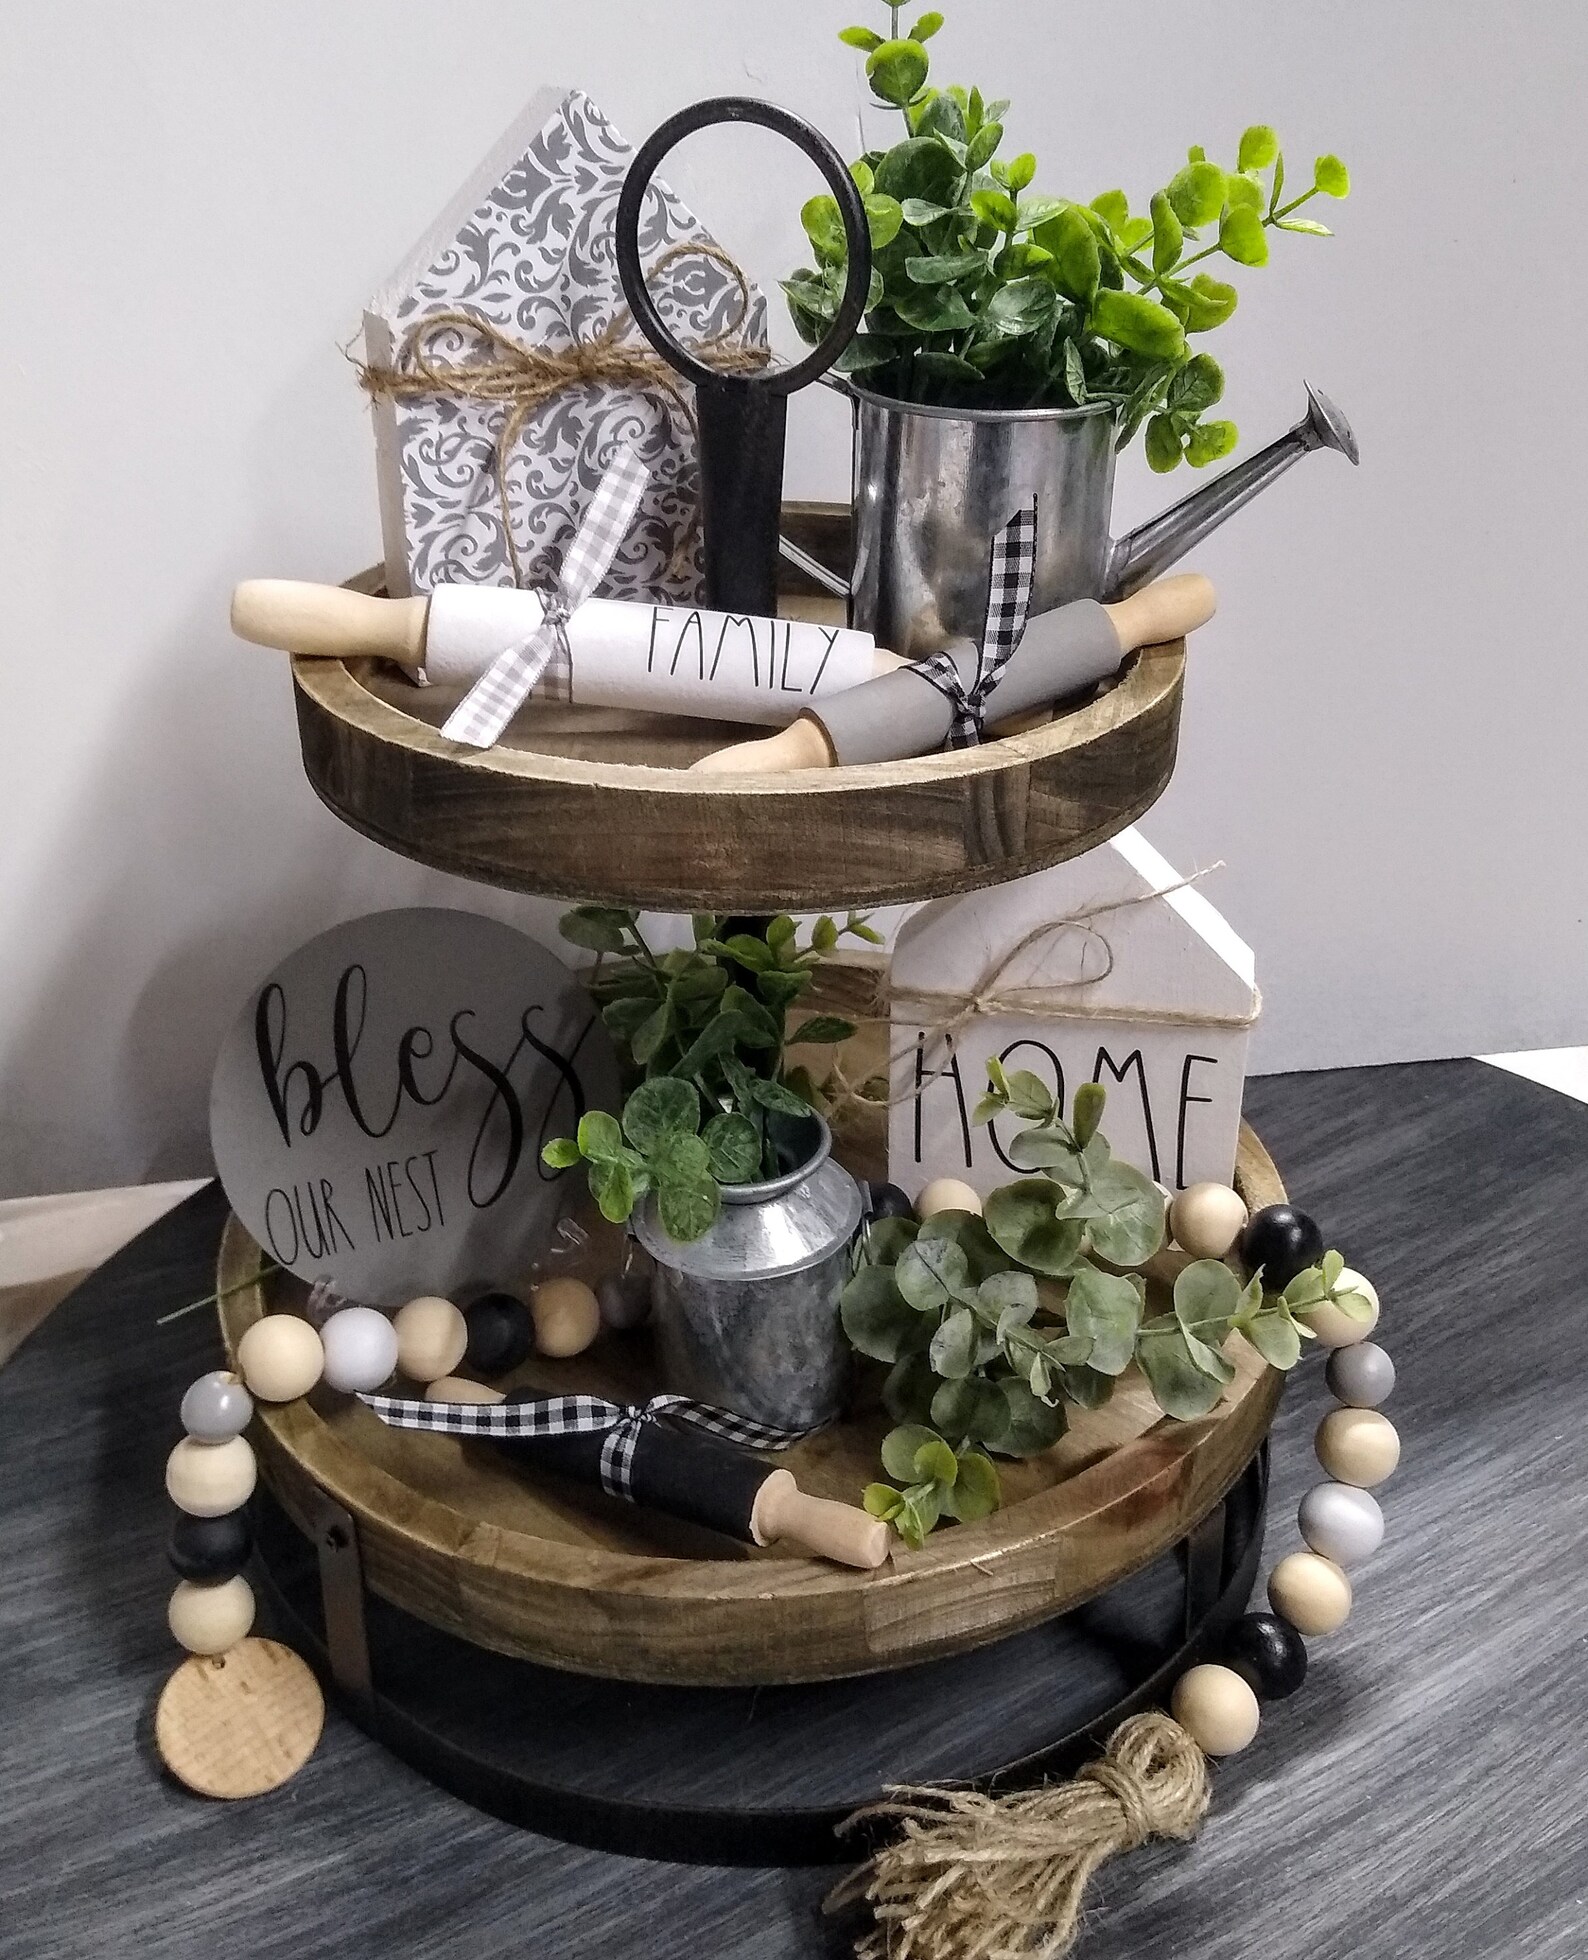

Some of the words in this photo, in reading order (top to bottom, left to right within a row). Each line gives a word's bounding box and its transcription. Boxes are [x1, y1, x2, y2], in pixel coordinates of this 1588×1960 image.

[647, 606, 839, 695] FAMILY
[255, 964, 596, 1209] bless
[914, 1031, 1218, 1190] HOME
[265, 1178, 355, 1266] OUR
[364, 1149, 445, 1243] NEST
